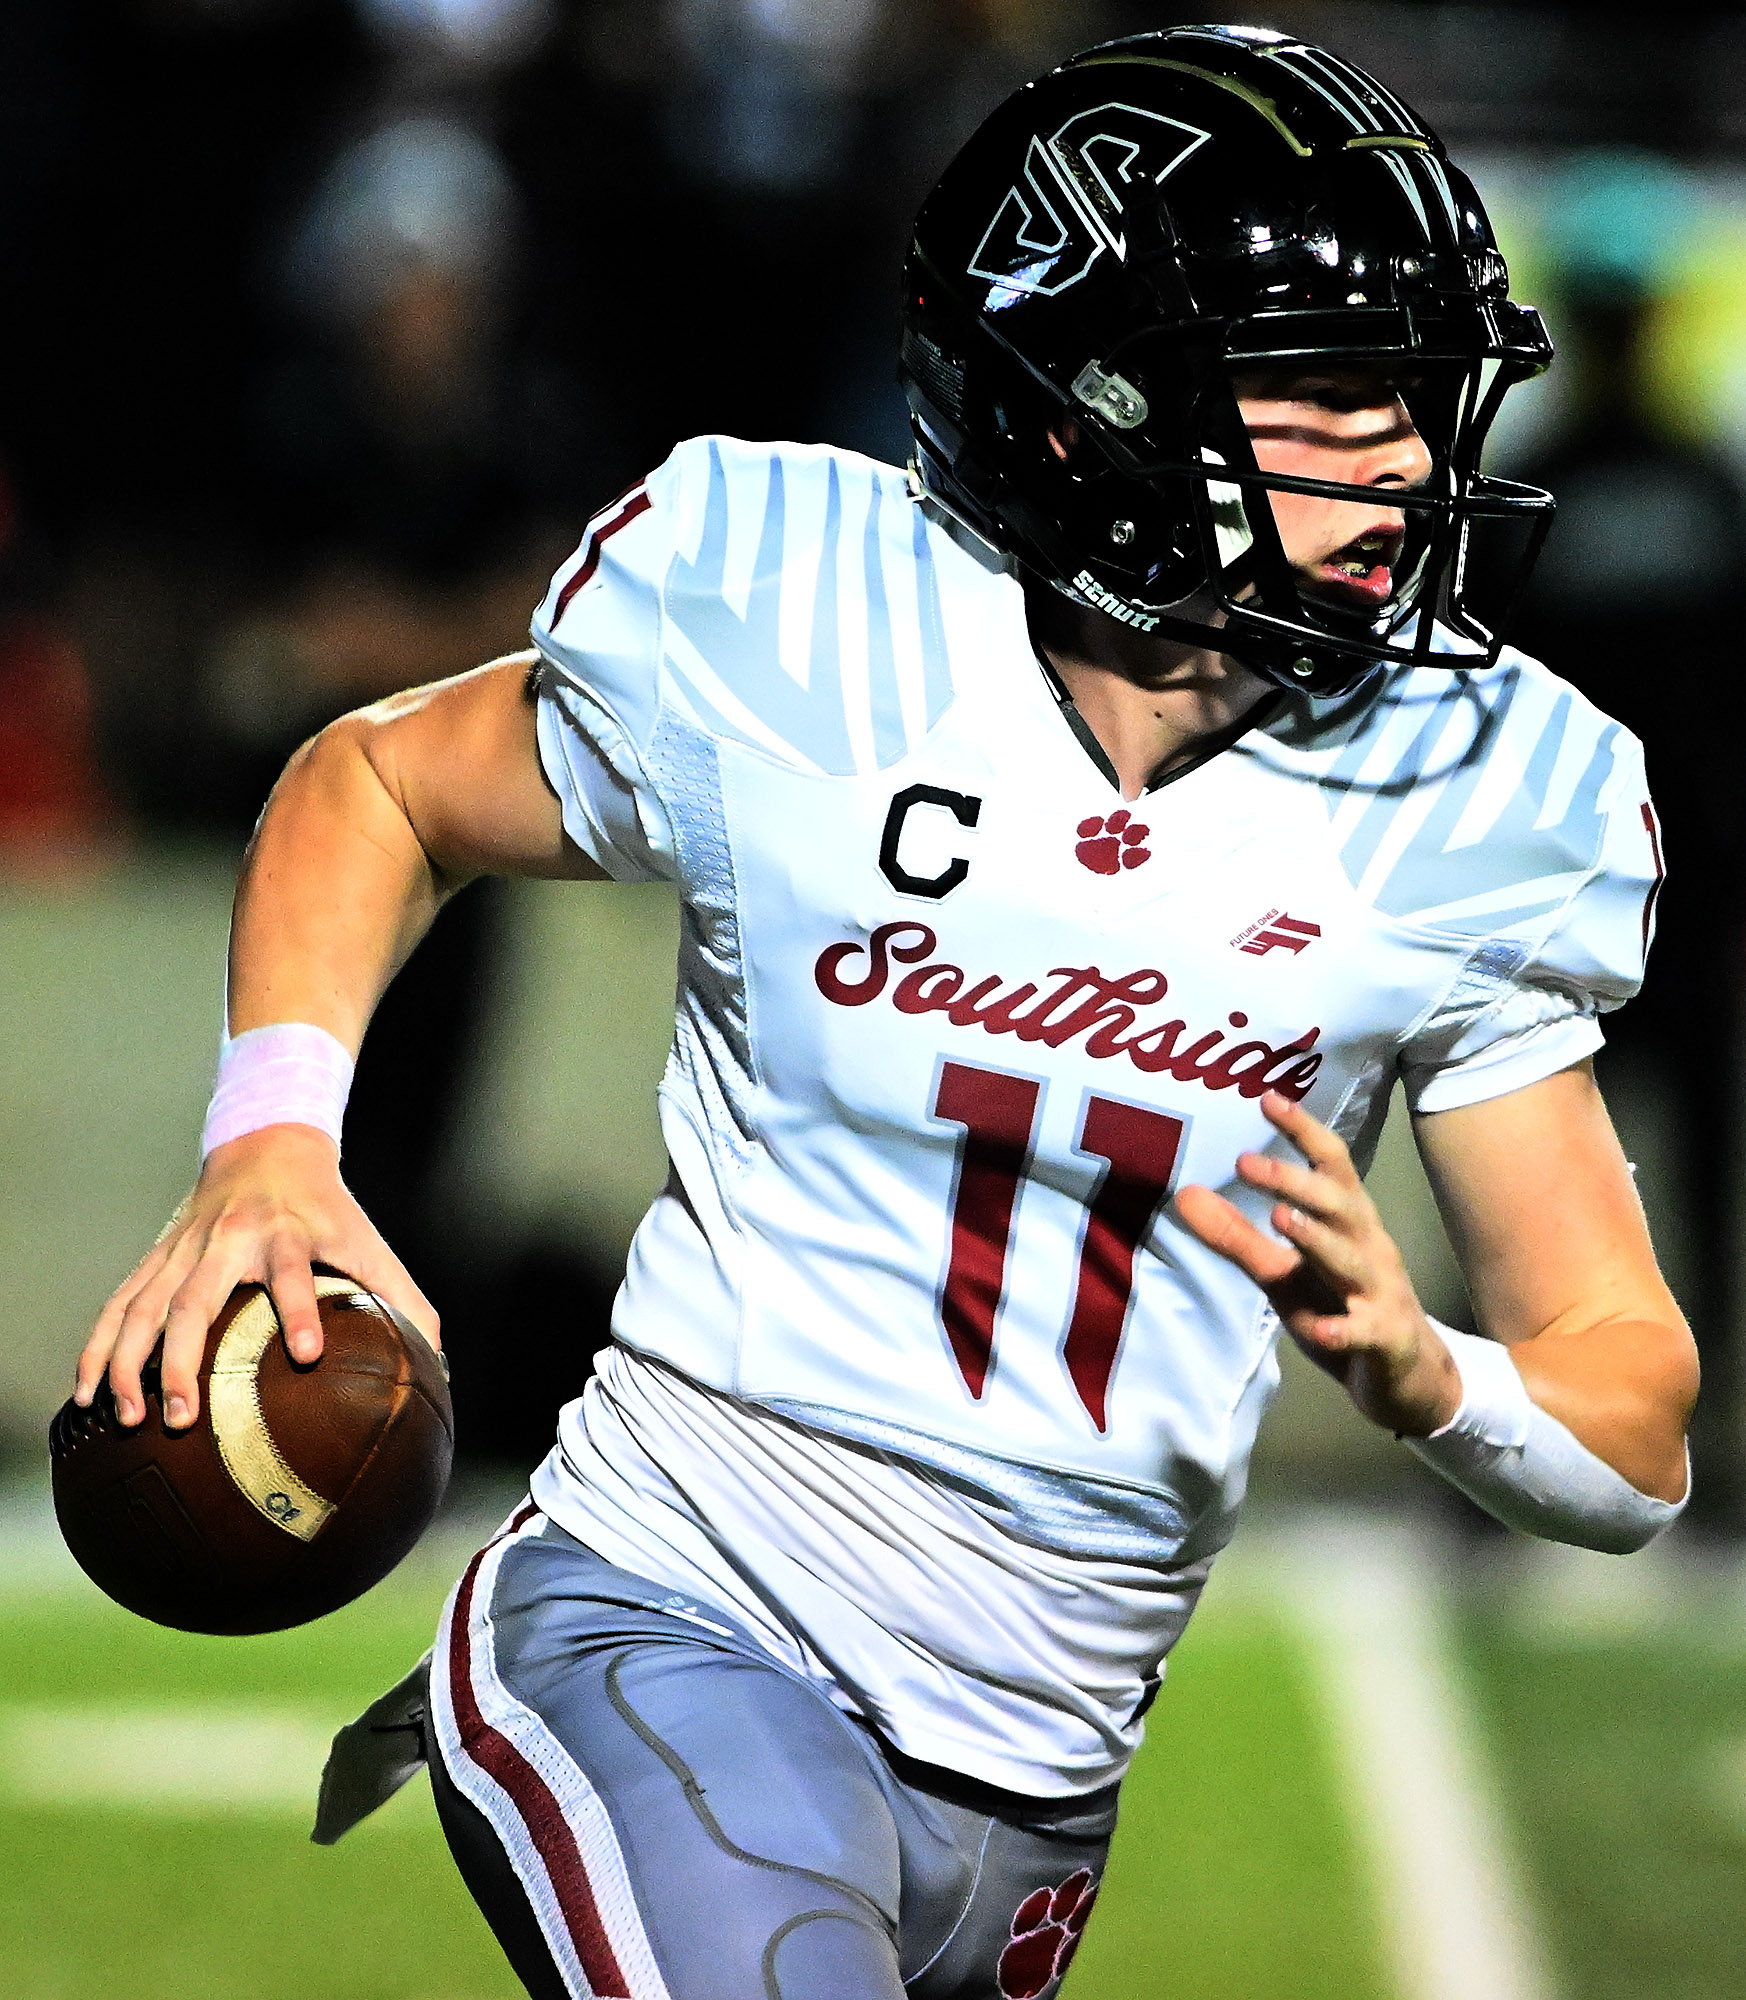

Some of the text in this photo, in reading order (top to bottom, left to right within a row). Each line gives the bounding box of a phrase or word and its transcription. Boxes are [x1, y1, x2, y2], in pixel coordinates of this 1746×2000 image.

[879, 783, 982, 899] C
[1229, 909, 1279, 947] FUTURE ONES
[815, 920, 1323, 1102] Southside
[932, 1058, 1186, 1436] 11
